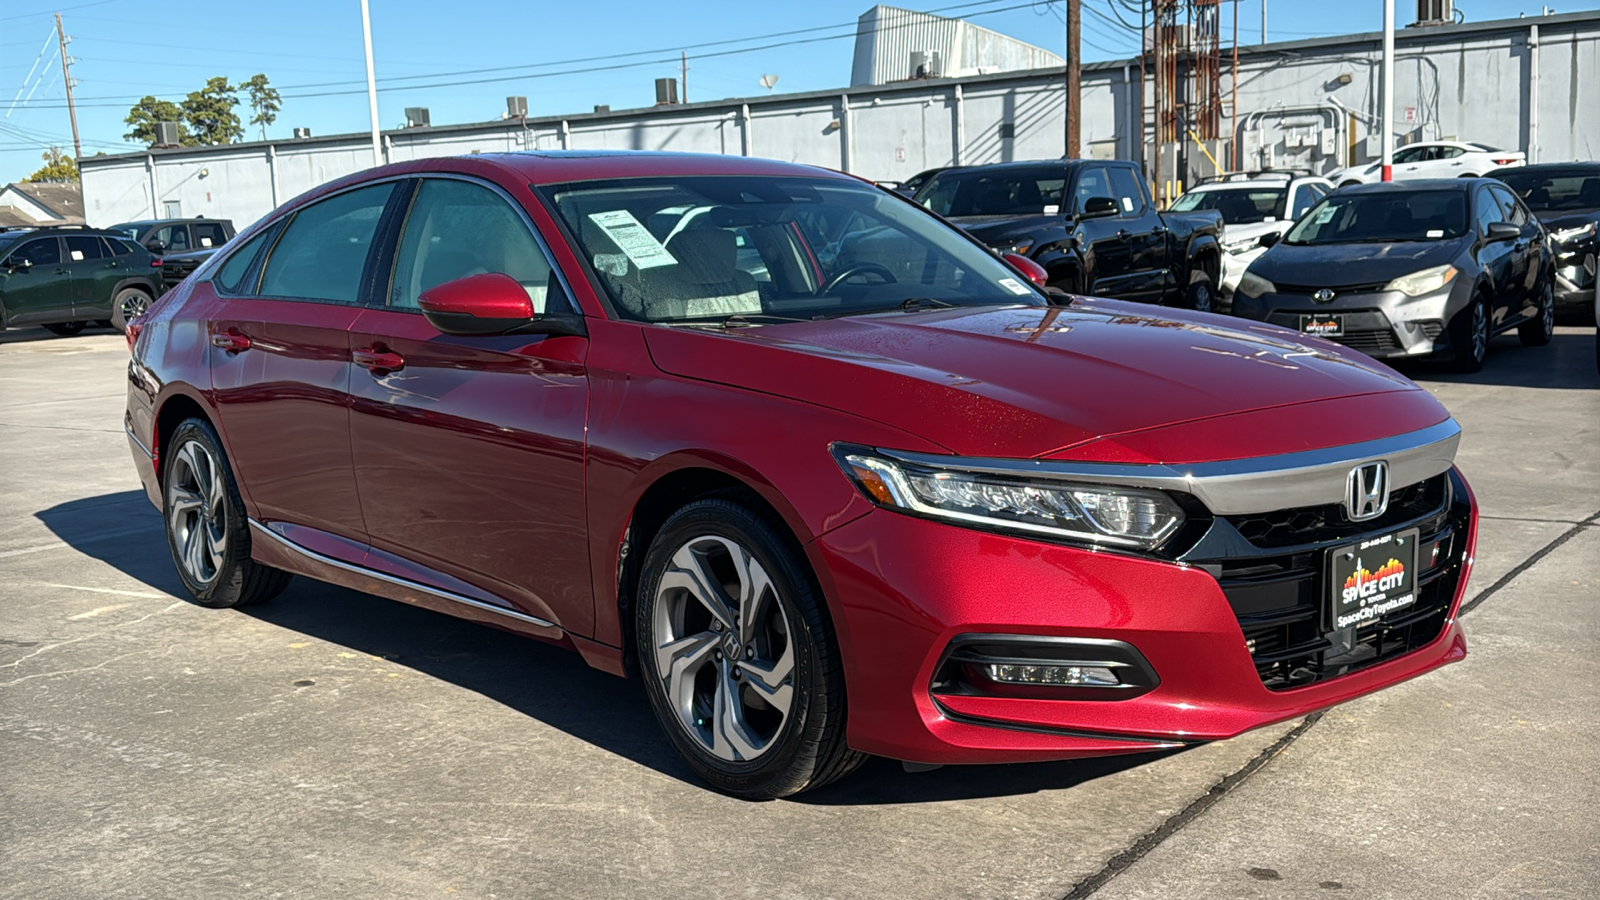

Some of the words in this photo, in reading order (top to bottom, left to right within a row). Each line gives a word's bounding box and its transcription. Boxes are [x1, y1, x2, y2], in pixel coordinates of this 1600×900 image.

[1342, 576, 1378, 604] SPACE
[1378, 571, 1405, 592] CITY
[1337, 593, 1414, 628] SpaceCityToyota.com
